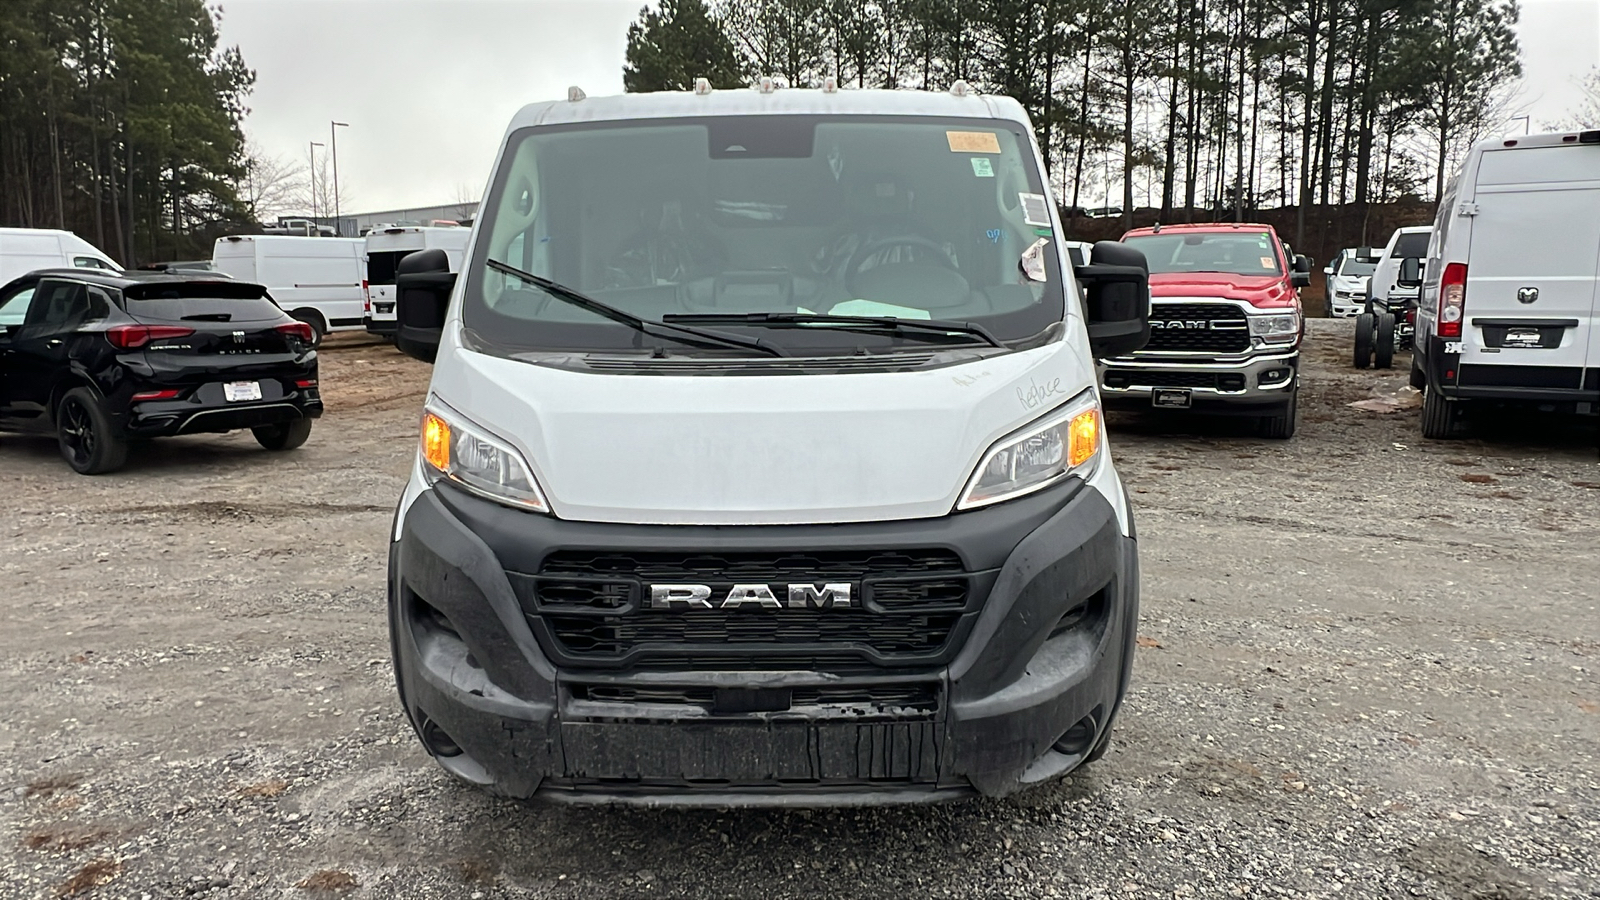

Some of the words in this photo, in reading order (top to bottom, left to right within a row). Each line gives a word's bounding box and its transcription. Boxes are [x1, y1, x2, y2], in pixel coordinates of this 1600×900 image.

[1147, 320, 1206, 329] RAM
[1015, 376, 1066, 411] Replace
[650, 583, 852, 609] RAM
